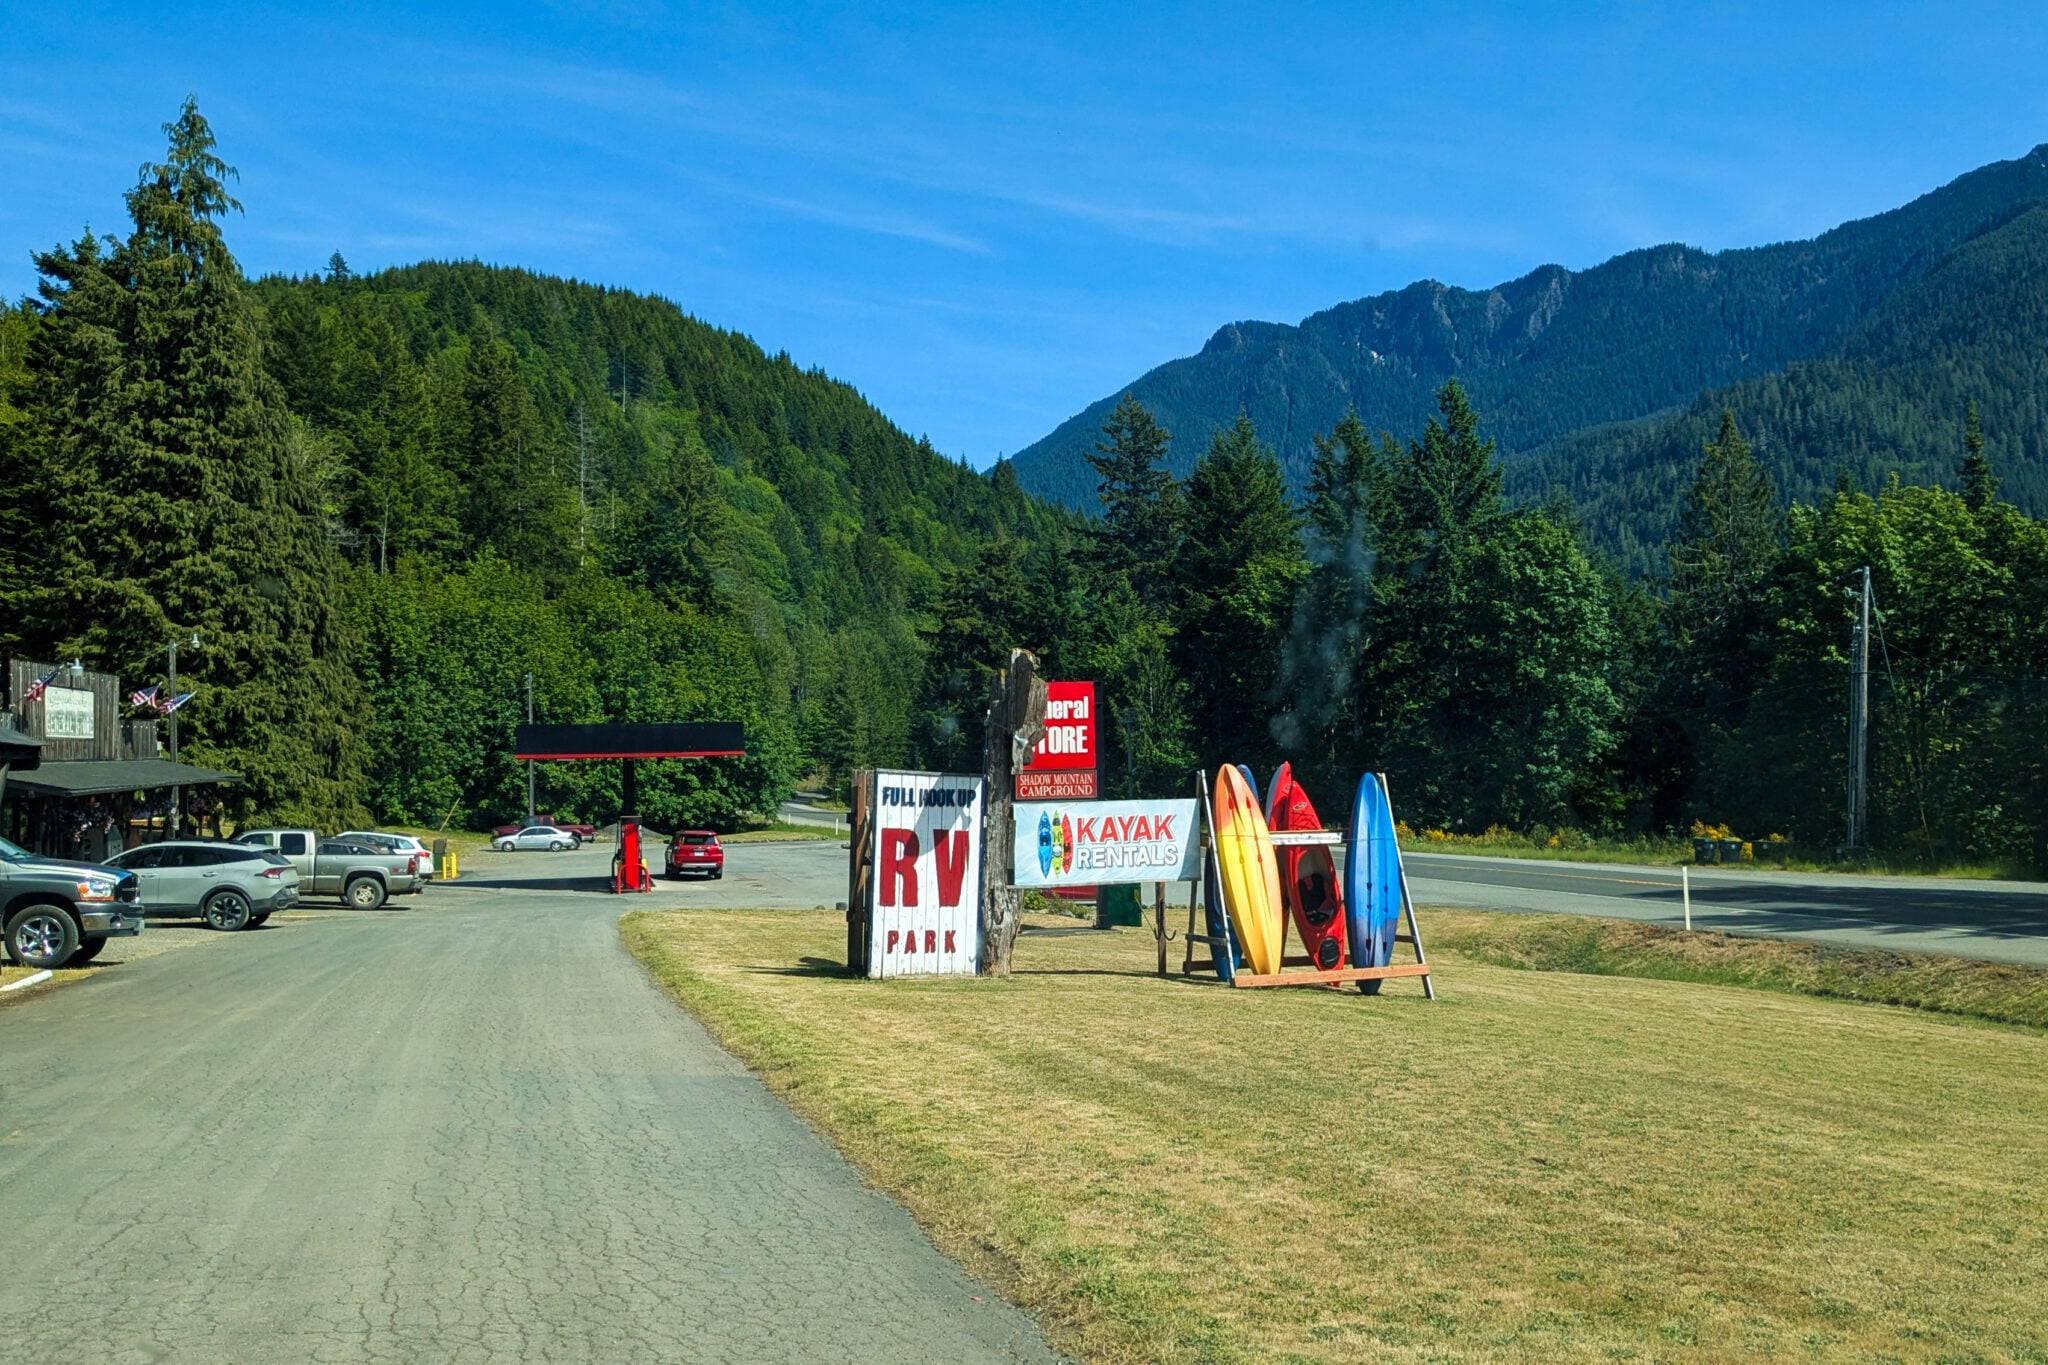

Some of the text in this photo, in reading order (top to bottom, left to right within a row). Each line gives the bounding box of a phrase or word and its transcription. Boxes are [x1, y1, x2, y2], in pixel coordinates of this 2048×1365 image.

[1032, 725, 1089, 754] TORE
[1020, 773, 1093, 785] SHADOW MOUNTAIN
[1020, 785, 1093, 797] CAMPGROUND
[882, 786, 976, 808] FULL HOOK UP
[1077, 814, 1175, 844] KAYAK
[879, 828, 970, 907] RV
[1077, 844, 1179, 869] RENTALS
[887, 930, 956, 954] PARK
